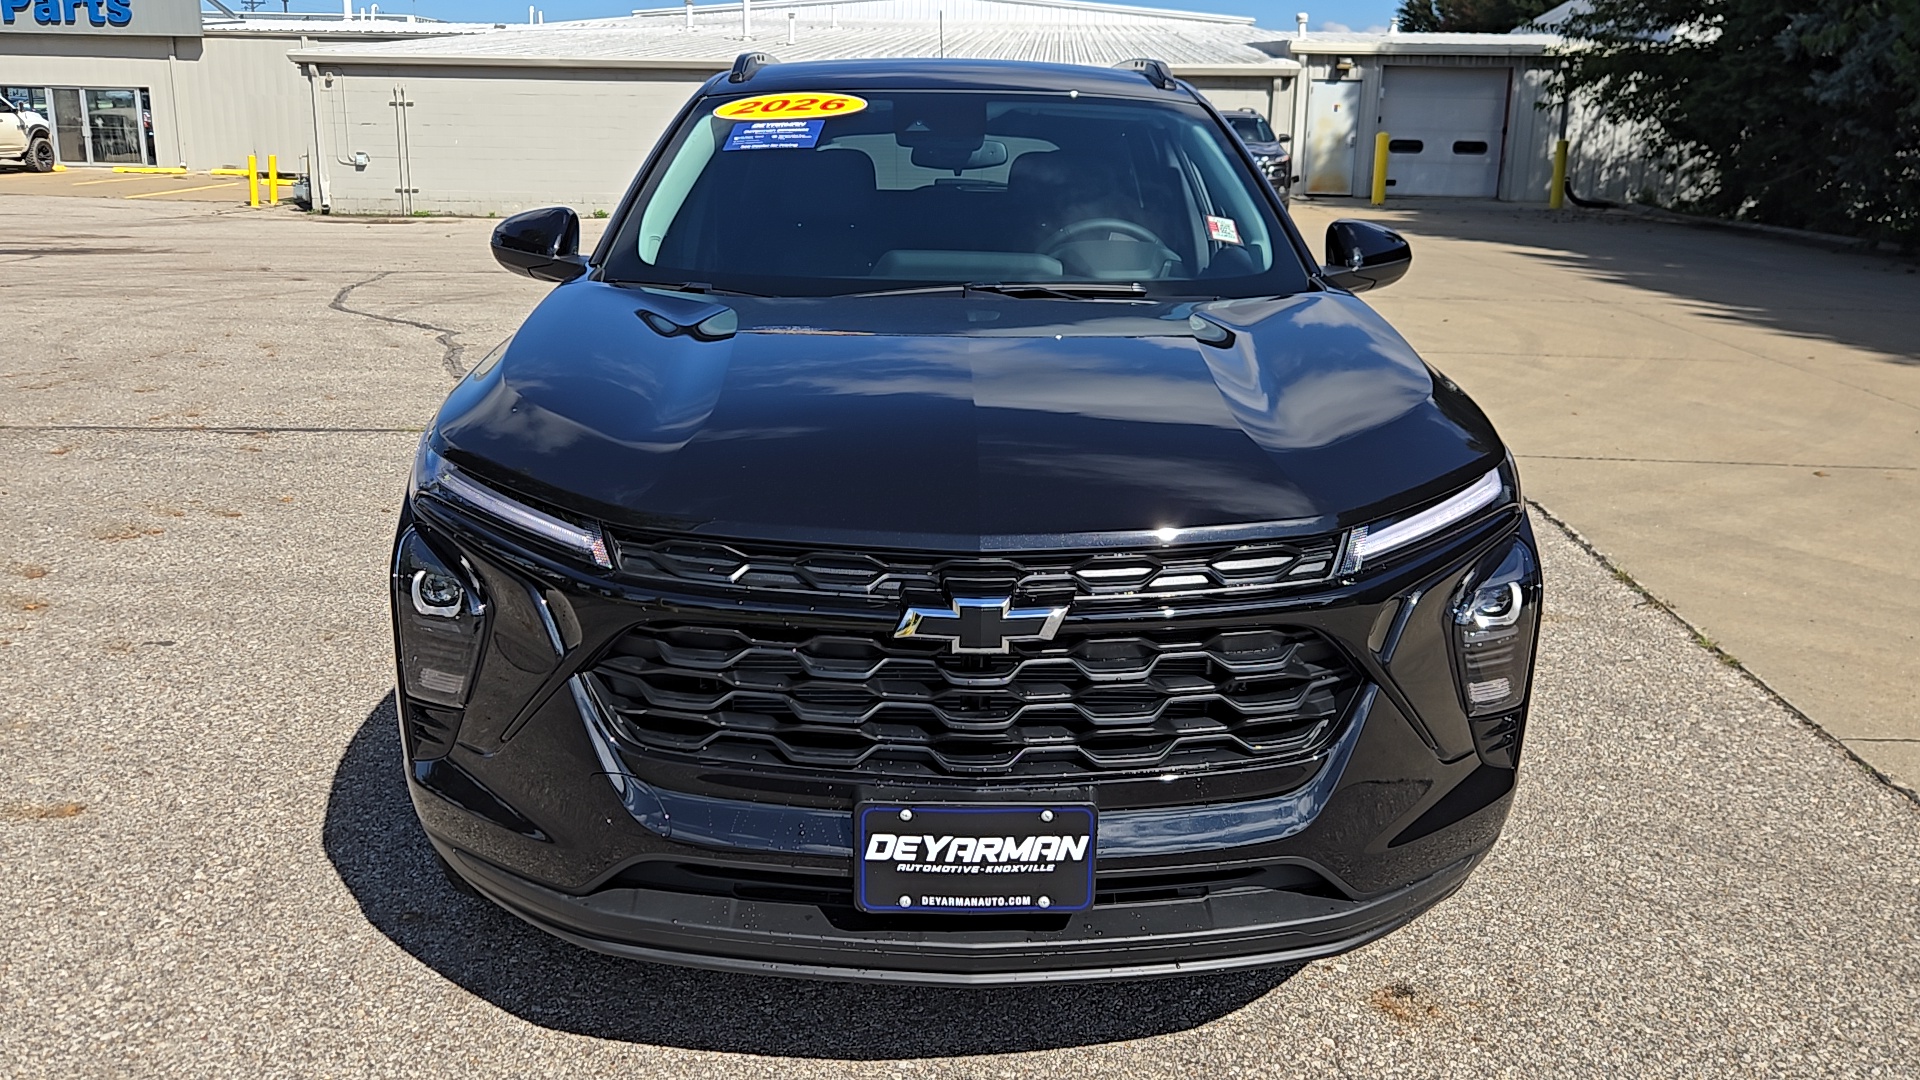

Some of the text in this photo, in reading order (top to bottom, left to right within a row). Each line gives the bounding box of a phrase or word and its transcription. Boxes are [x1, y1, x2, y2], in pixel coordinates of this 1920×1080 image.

[729, 99, 849, 115] 2026
[865, 834, 1090, 862] DEYARMAN
[921, 896, 1031, 906] DEYARMANAUTO.COM
